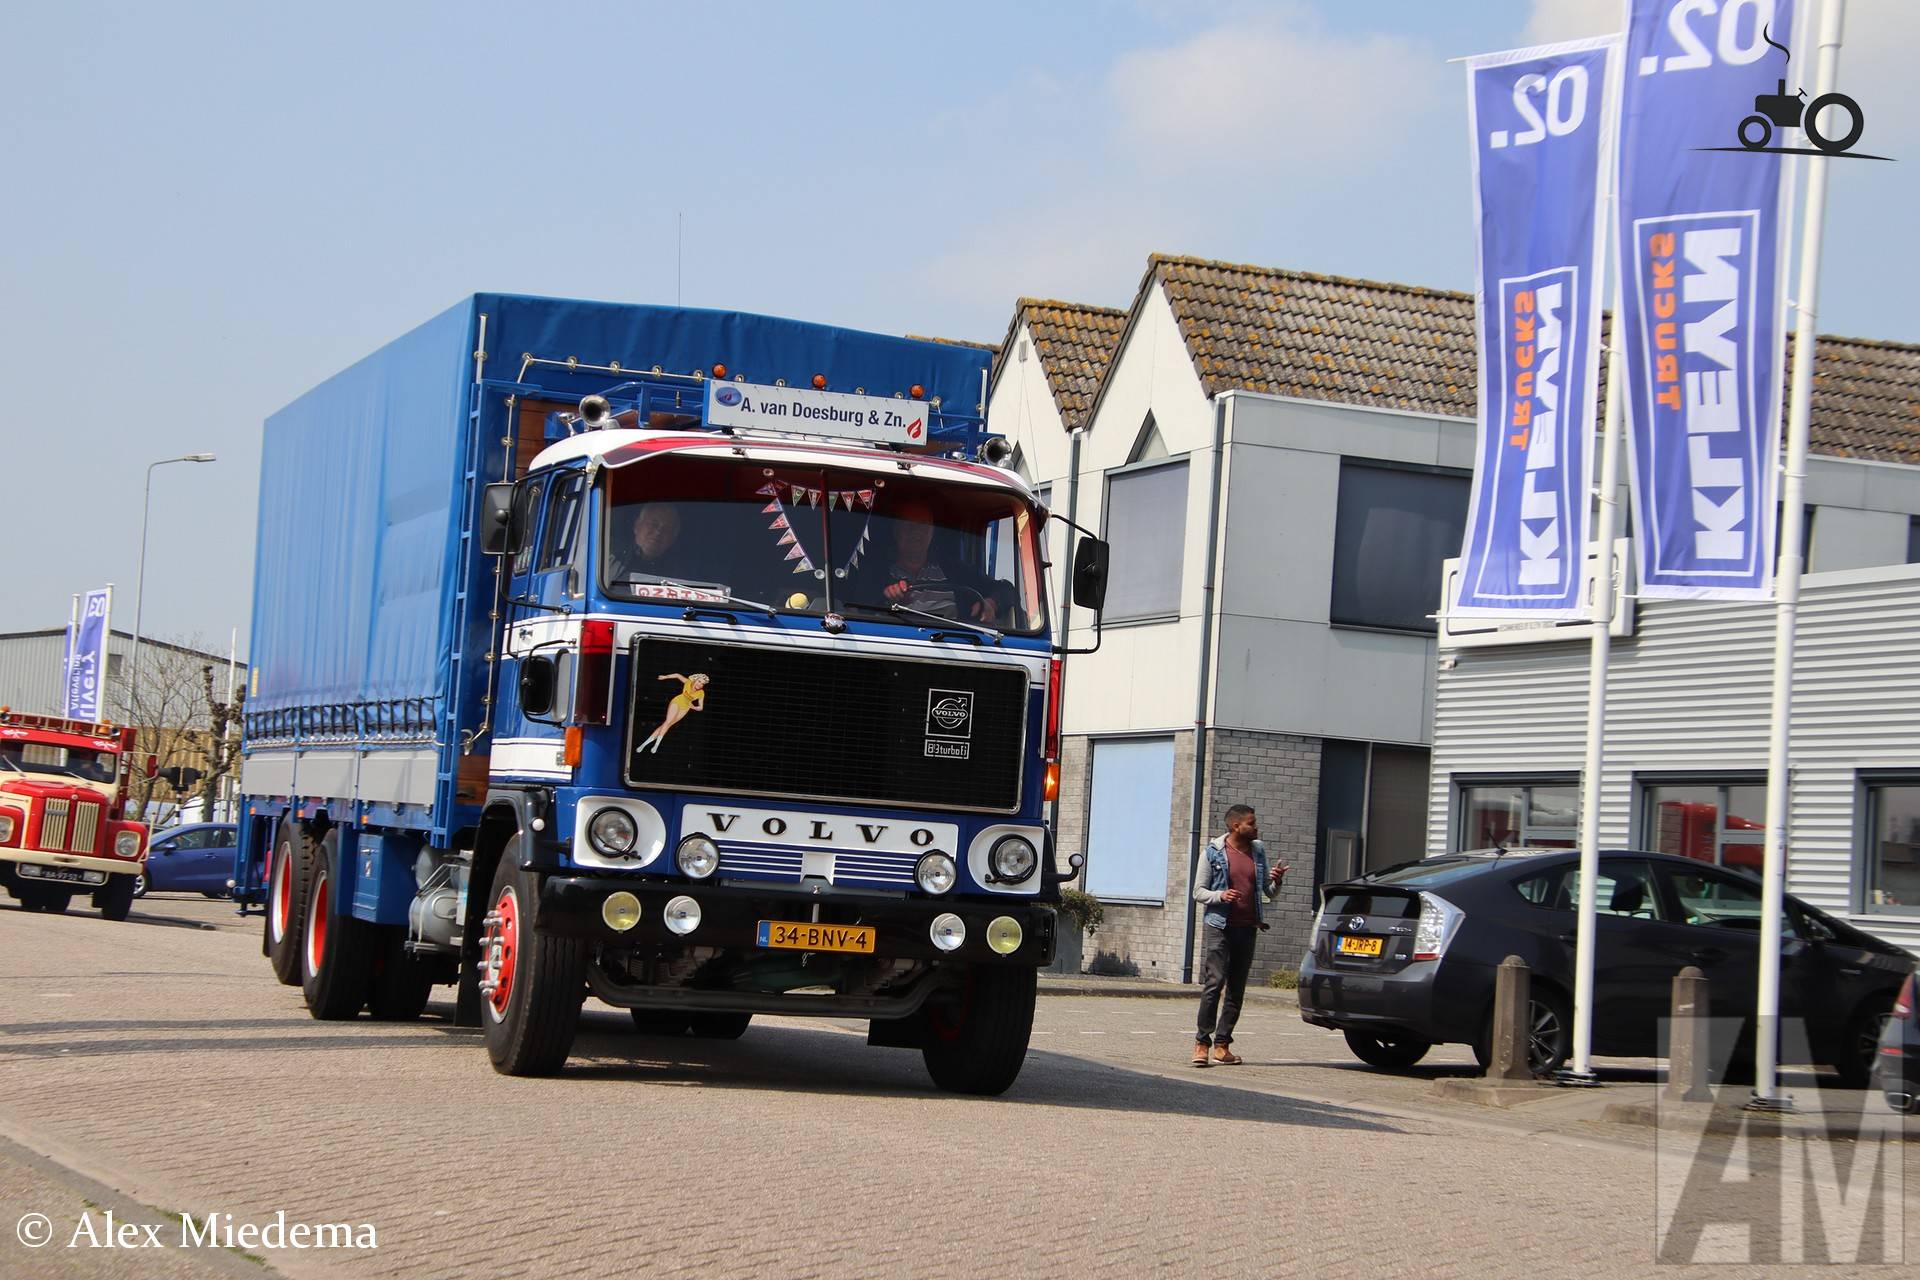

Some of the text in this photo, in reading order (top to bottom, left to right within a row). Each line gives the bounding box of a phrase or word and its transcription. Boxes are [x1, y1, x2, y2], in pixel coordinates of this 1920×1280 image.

[741, 397, 906, 427] A. van Doesburg & Zn.
[935, 709, 966, 718] VOLVO
[707, 813, 934, 846] VOLVO
[774, 926, 867, 949] 34-BNV-4
